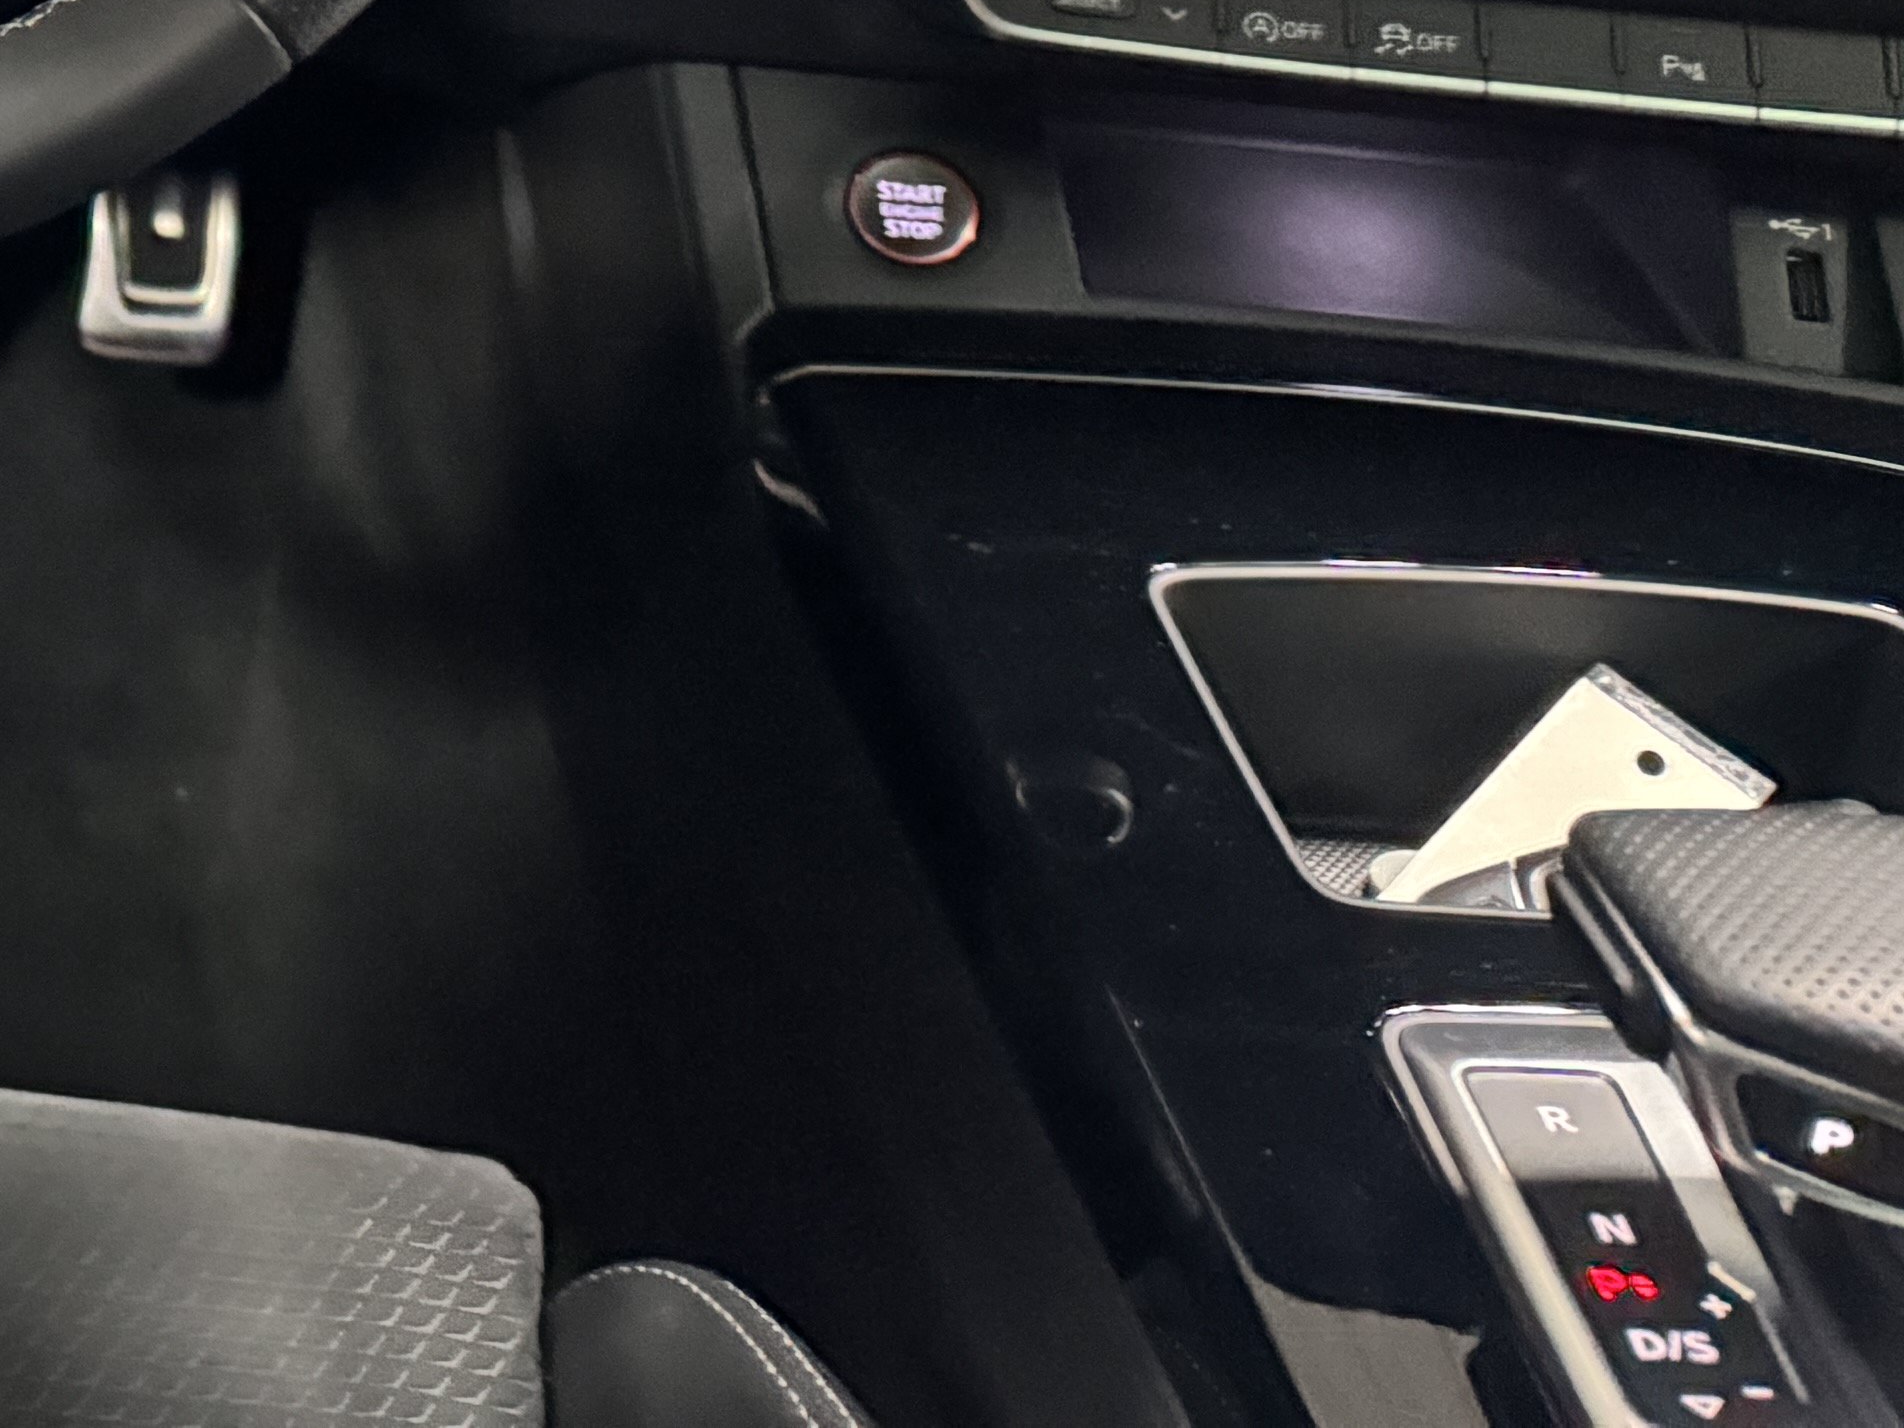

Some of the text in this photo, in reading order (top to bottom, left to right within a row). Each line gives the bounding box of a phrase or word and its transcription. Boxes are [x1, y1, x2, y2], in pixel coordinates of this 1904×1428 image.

[1280, 20, 1326, 42] OFF
[1416, 33, 1462, 54] OFF
[875, 179, 947, 205] START
[883, 218, 944, 240] STOP
[1535, 1104, 1580, 1135] R
[1809, 1115, 1856, 1156] P
[1587, 1211, 1639, 1245] N
